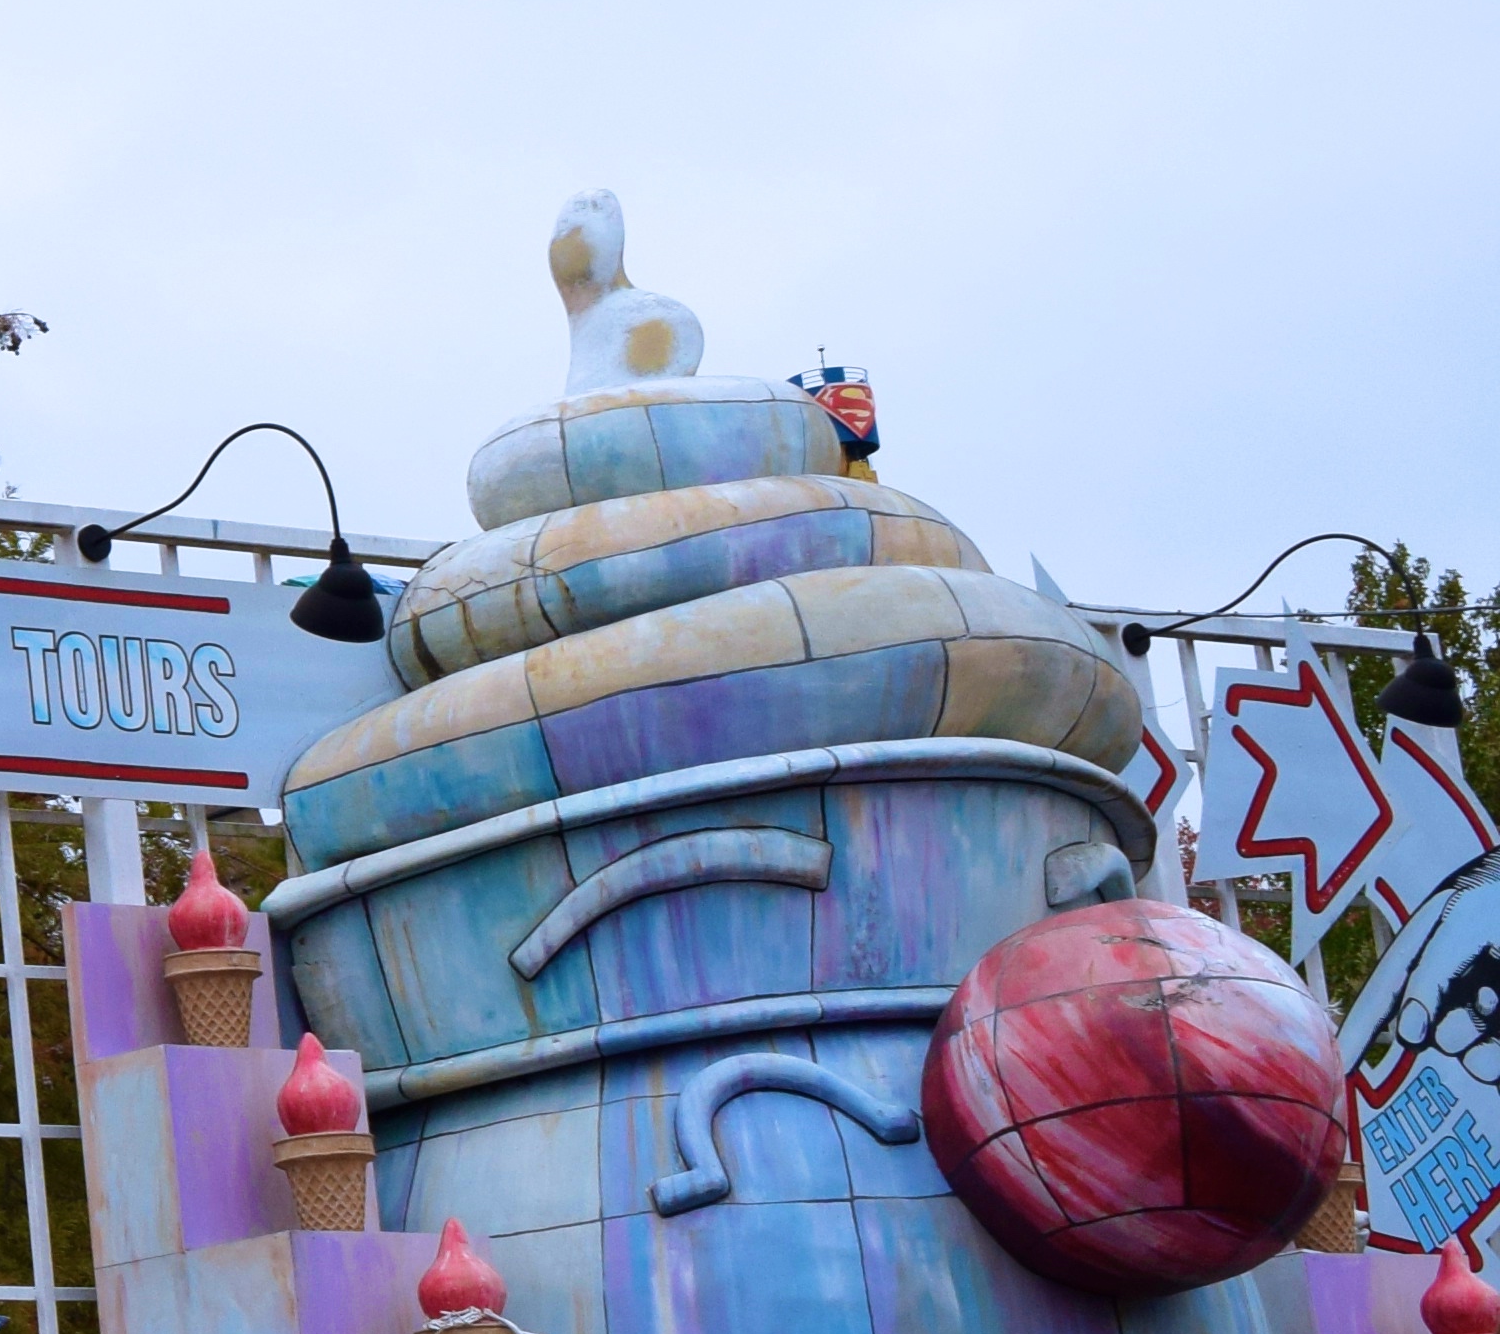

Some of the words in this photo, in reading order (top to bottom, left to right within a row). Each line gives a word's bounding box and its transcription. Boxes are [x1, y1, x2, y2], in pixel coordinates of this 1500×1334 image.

[11, 626, 240, 739] TOURS
[1361, 1065, 1460, 1175] ENTER
[1389, 1109, 1500, 1254] HERE
